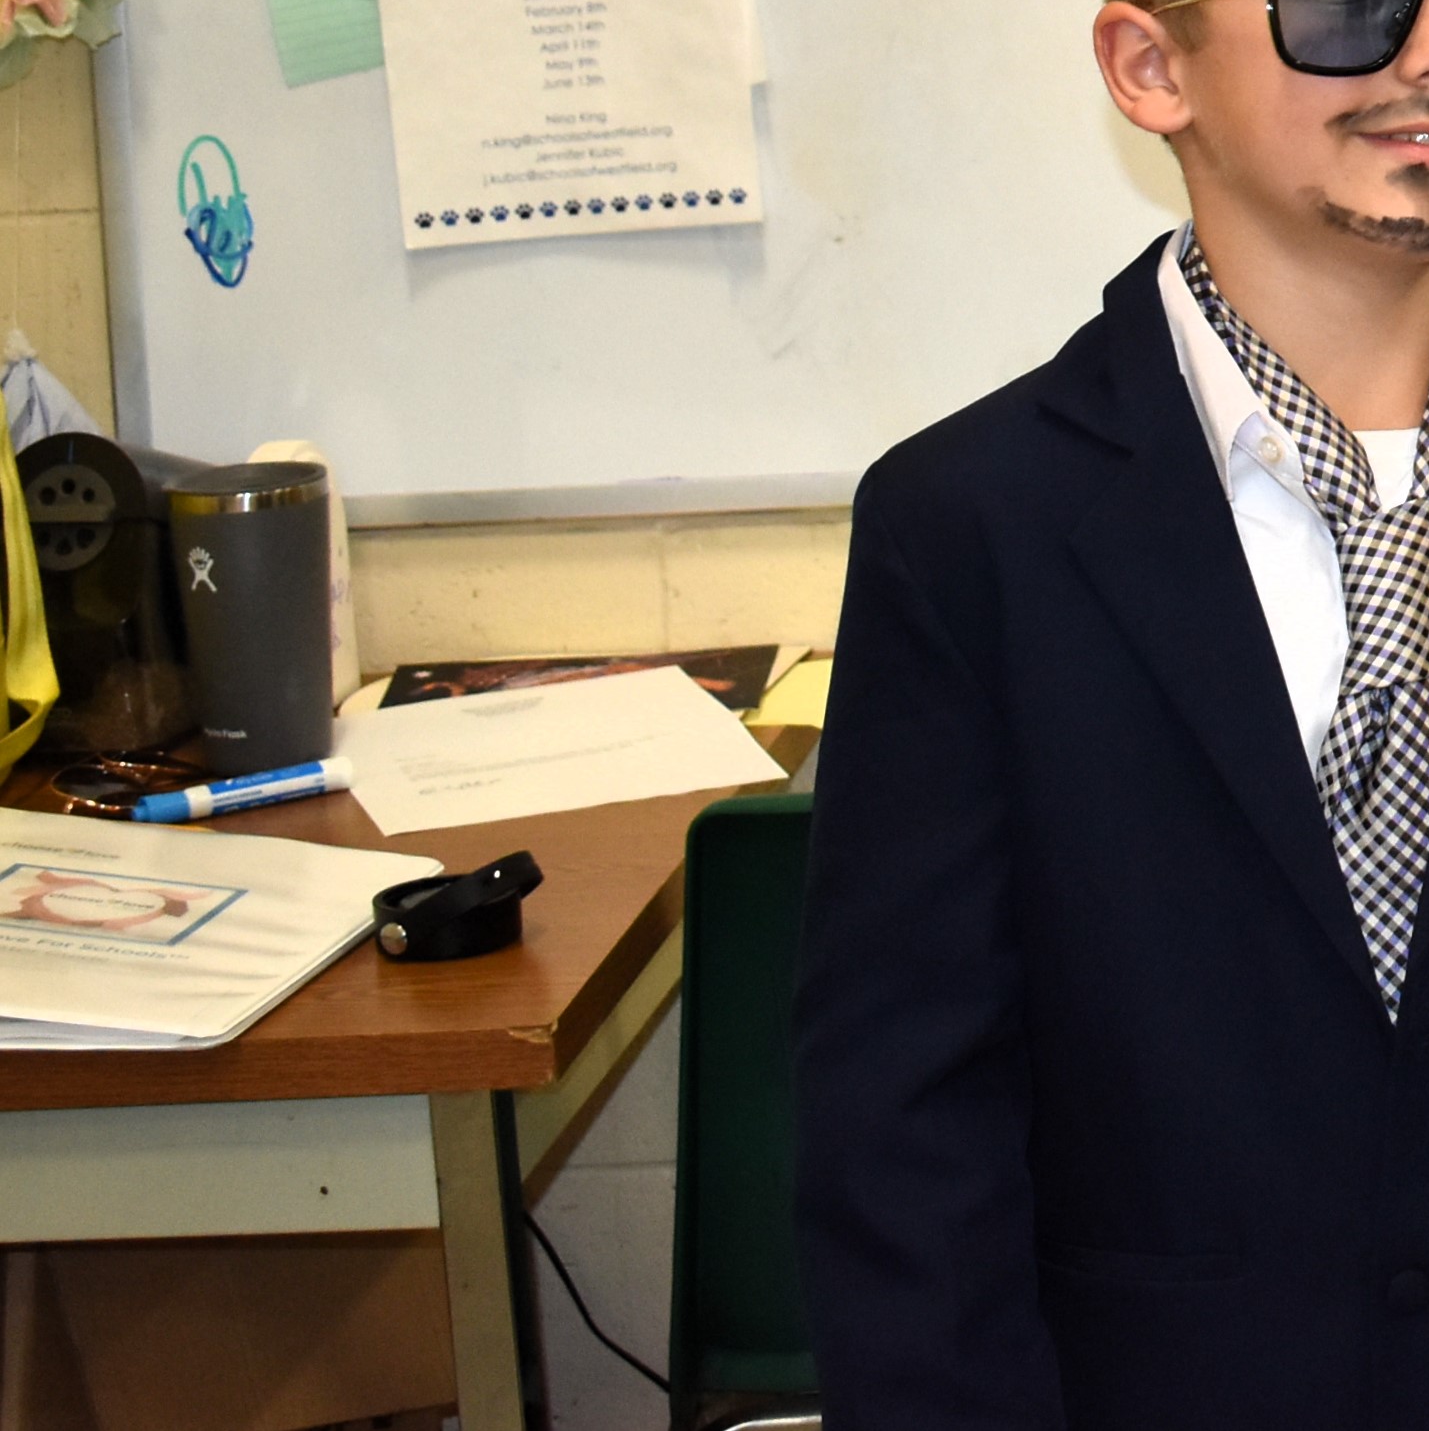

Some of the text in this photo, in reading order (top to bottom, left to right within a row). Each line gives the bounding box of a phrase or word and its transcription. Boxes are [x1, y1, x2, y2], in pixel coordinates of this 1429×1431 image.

[524, 3, 584, 19] February
[531, 23, 575, 36] March
[540, 39, 570, 55] April
[545, 58, 574, 72] May
[542, 76, 574, 90] June
[579, 110, 608, 124] King
